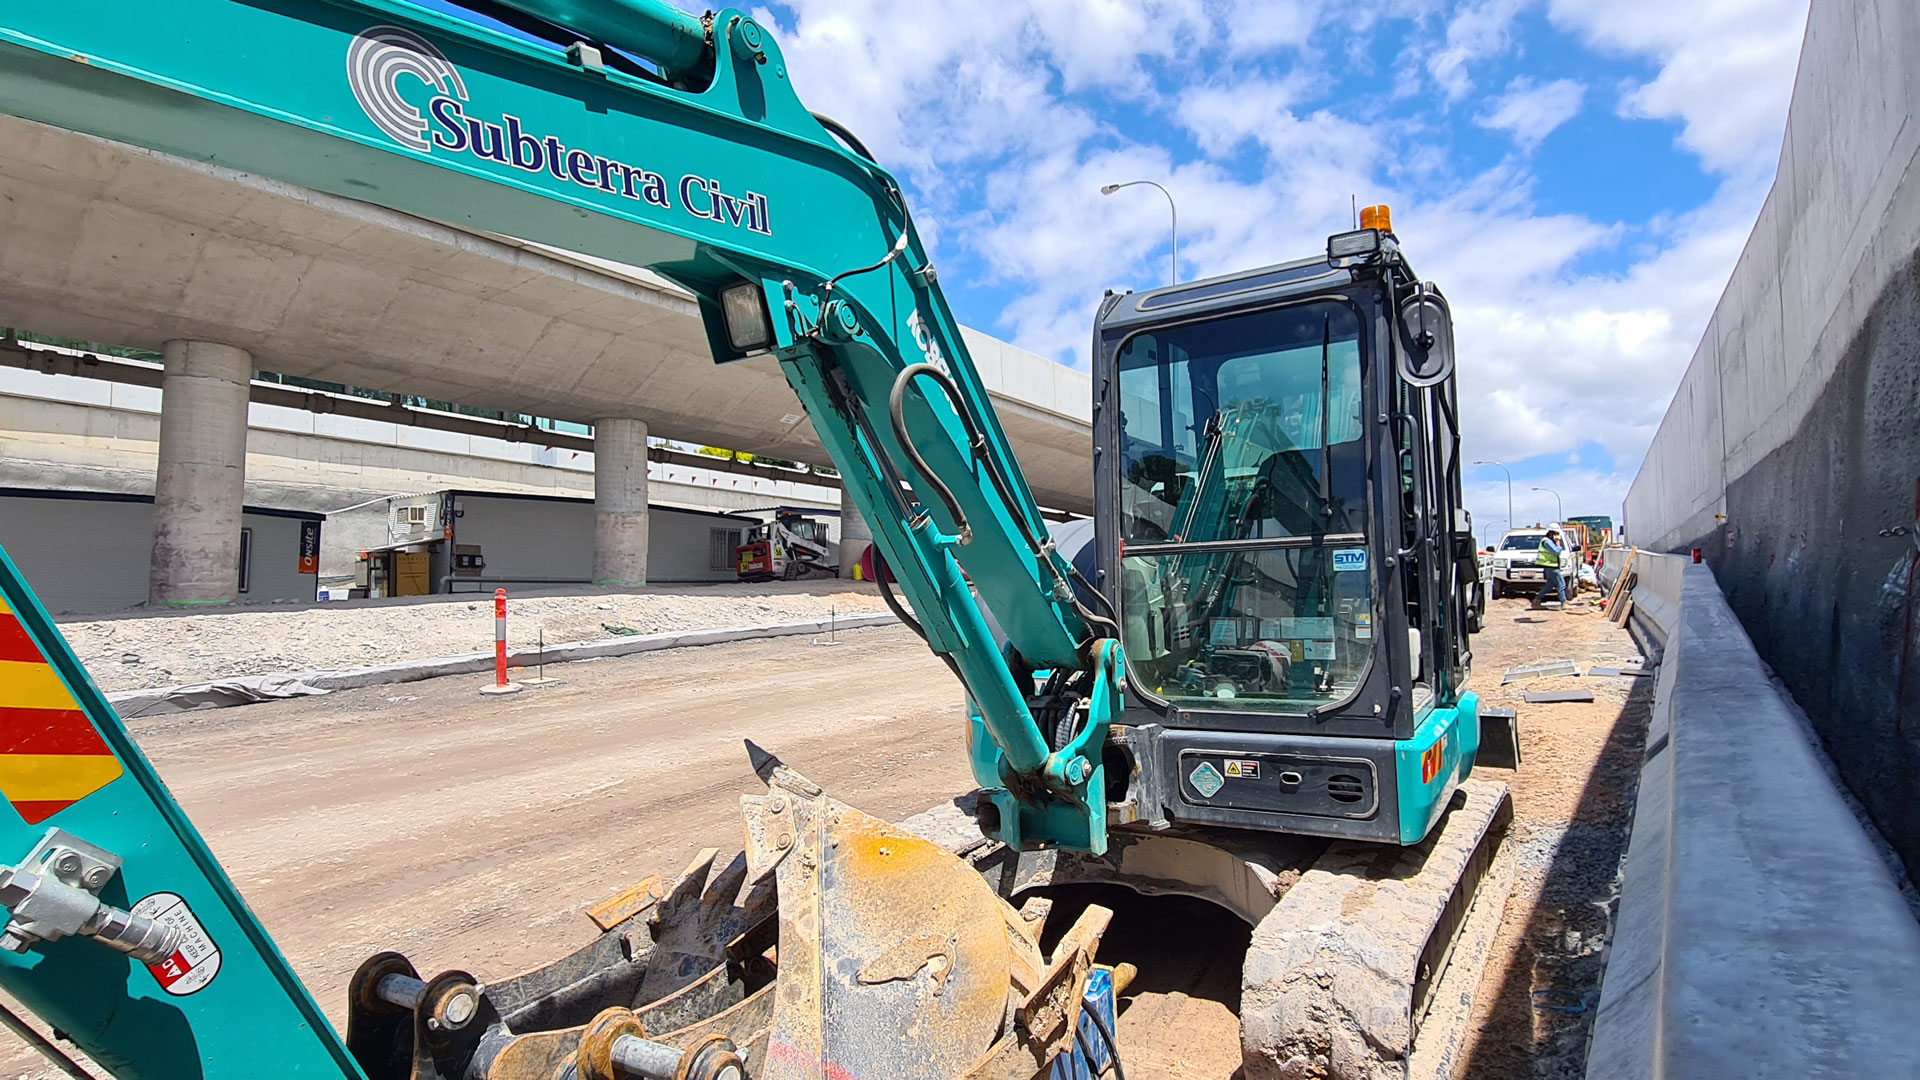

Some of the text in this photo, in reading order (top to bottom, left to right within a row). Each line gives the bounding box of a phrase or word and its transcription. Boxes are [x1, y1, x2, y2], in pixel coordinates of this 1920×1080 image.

[429, 96, 772, 236] Subterra Civil
[1335, 552, 1365, 564] STM
[164, 916, 175, 925] OF
[174, 909, 207, 952] MACHINE
[185, 944, 200, 960] KEEP
